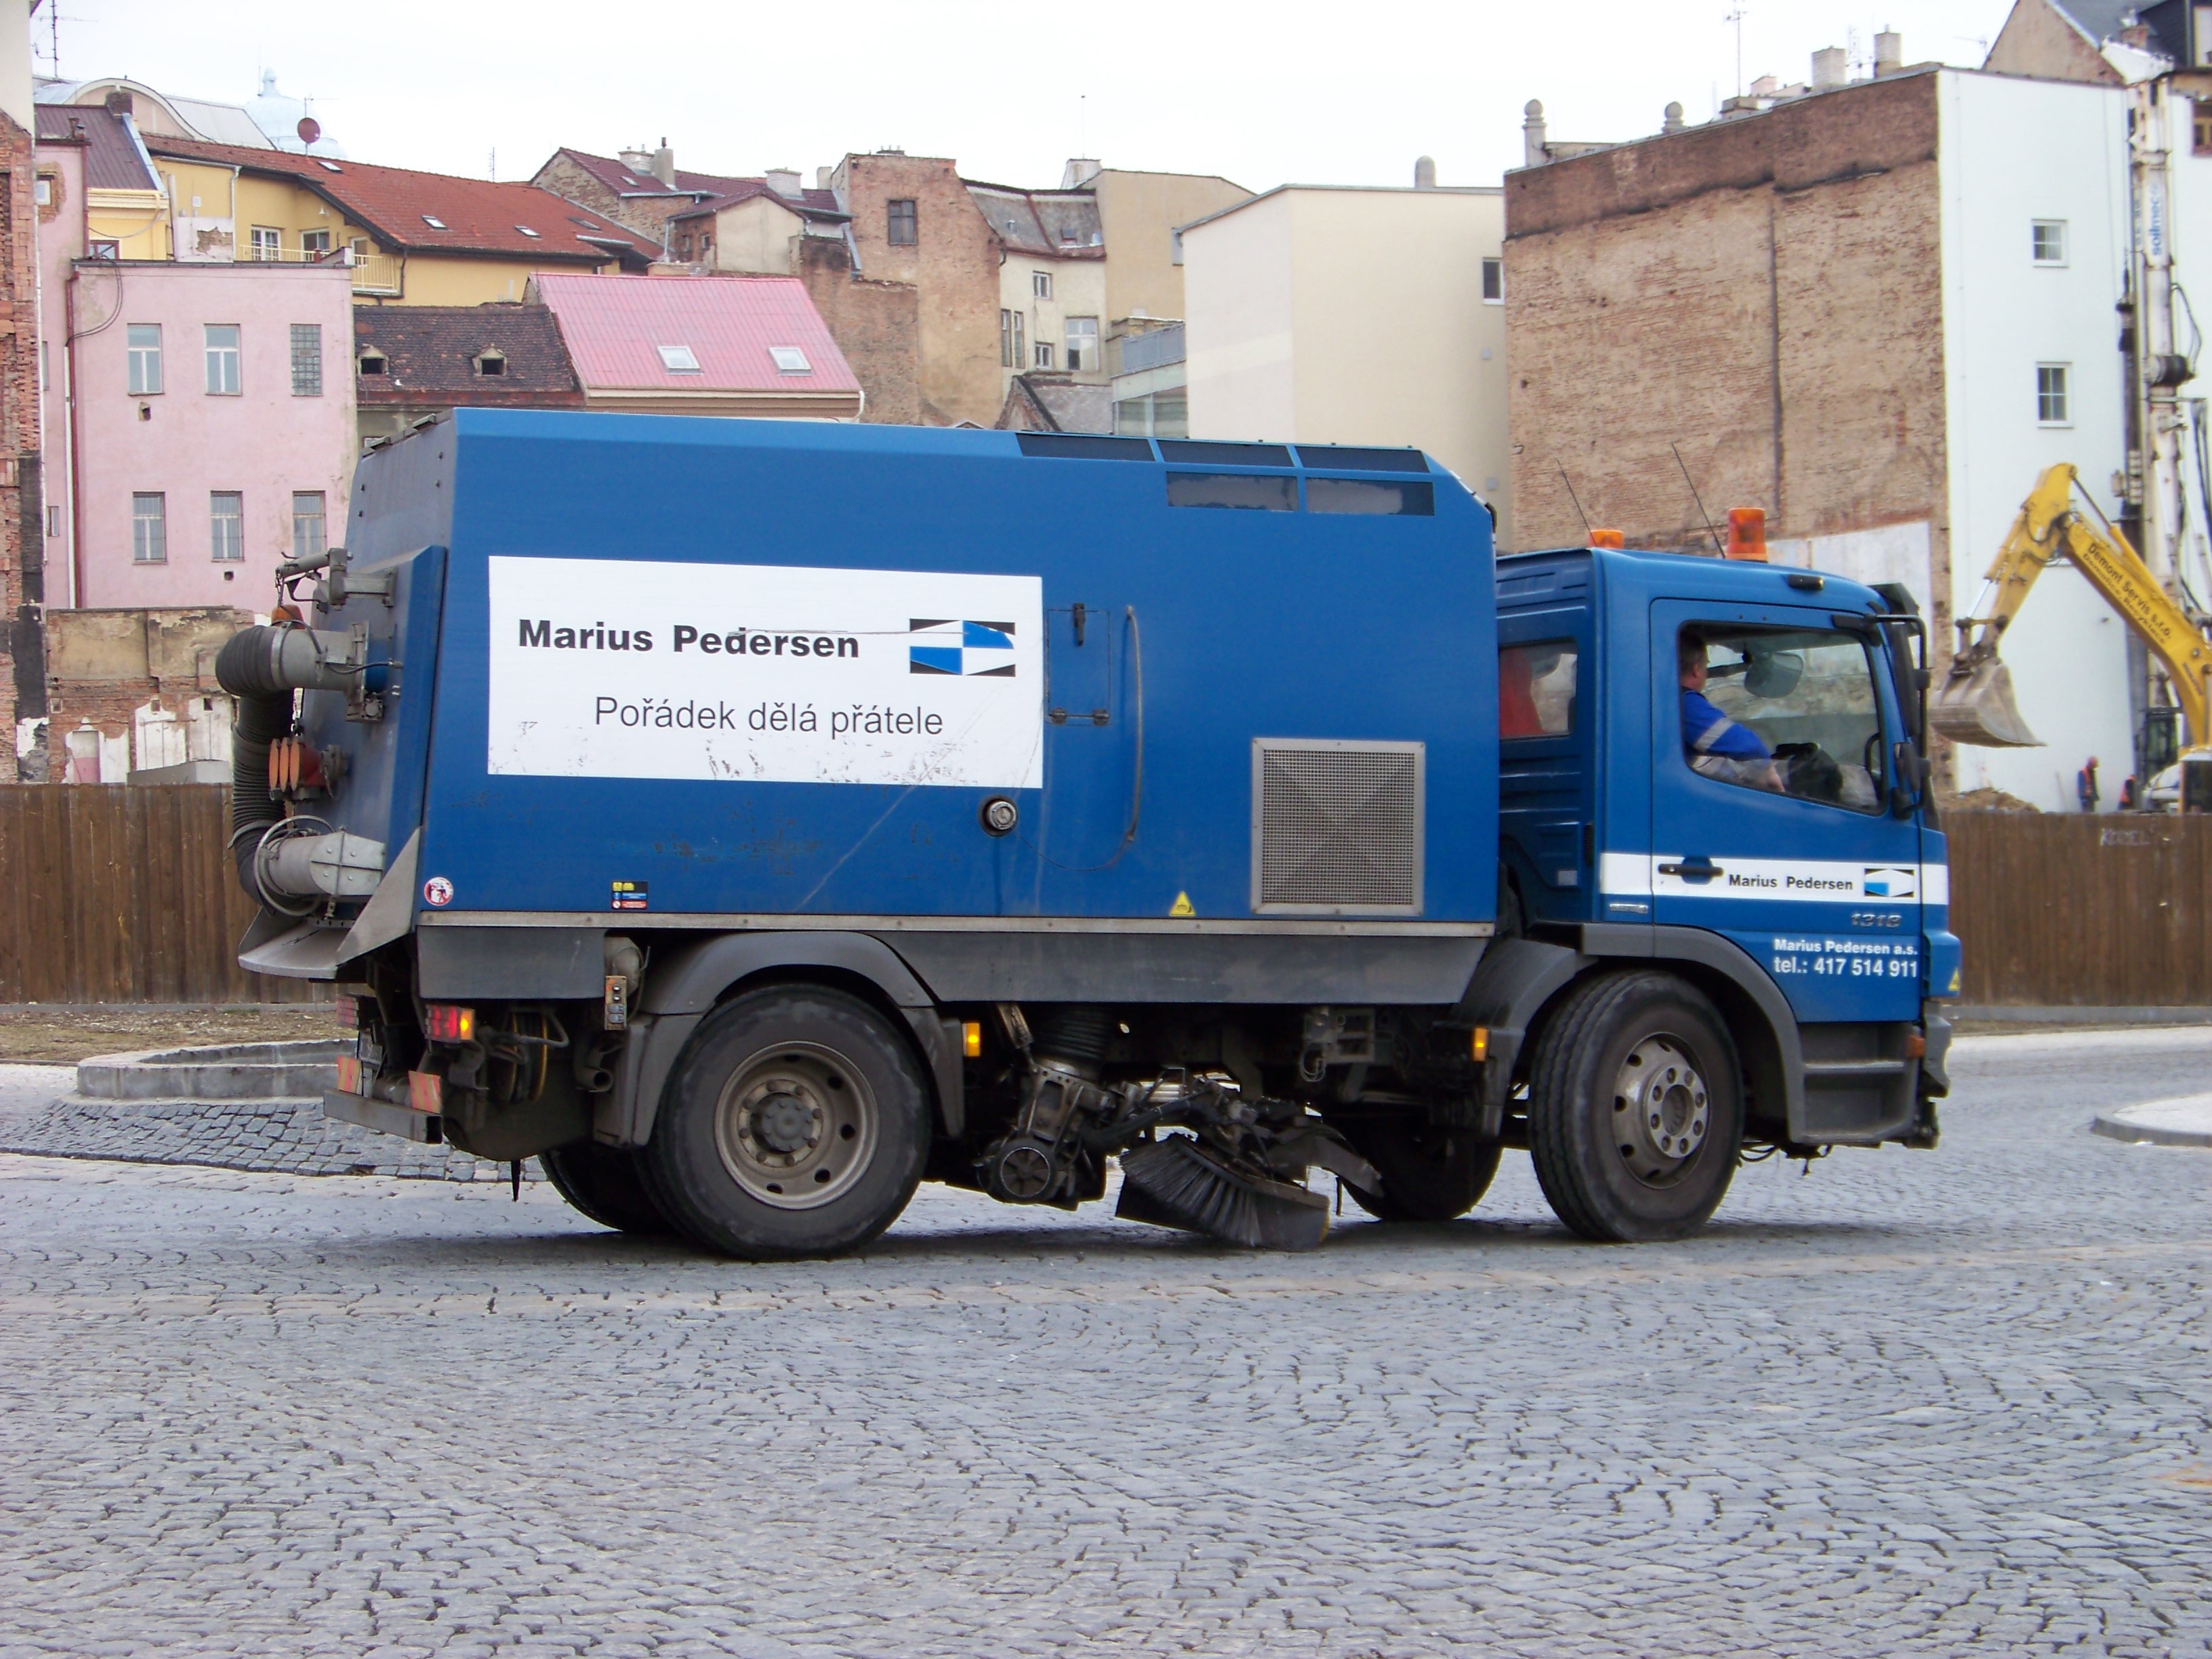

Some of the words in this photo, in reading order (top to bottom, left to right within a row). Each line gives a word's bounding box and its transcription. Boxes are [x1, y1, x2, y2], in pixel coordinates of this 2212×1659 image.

[2088, 543, 2124, 583] Demont
[2123, 581, 2150, 615] Servis
[519, 619, 653, 651] Marius
[674, 625, 859, 657] Pedersen
[596, 696, 736, 729] Pořádek
[748, 701, 817, 732] dělá
[832, 704, 943, 739] přátele
[1729, 874, 1778, 888] Marius
[1786, 876, 1853, 890] Pedersen
[1851, 914, 1902, 928] 1318
[1774, 939, 1822, 952] Marius
[1825, 940, 1890, 954] Pedersen
[1893, 945, 1918, 955] a.s.
[1774, 956, 1808, 974] tel.:
[1814, 957, 1847, 975] 417
[1851, 958, 1884, 977] 514
[1889, 960, 1917, 978] 911
